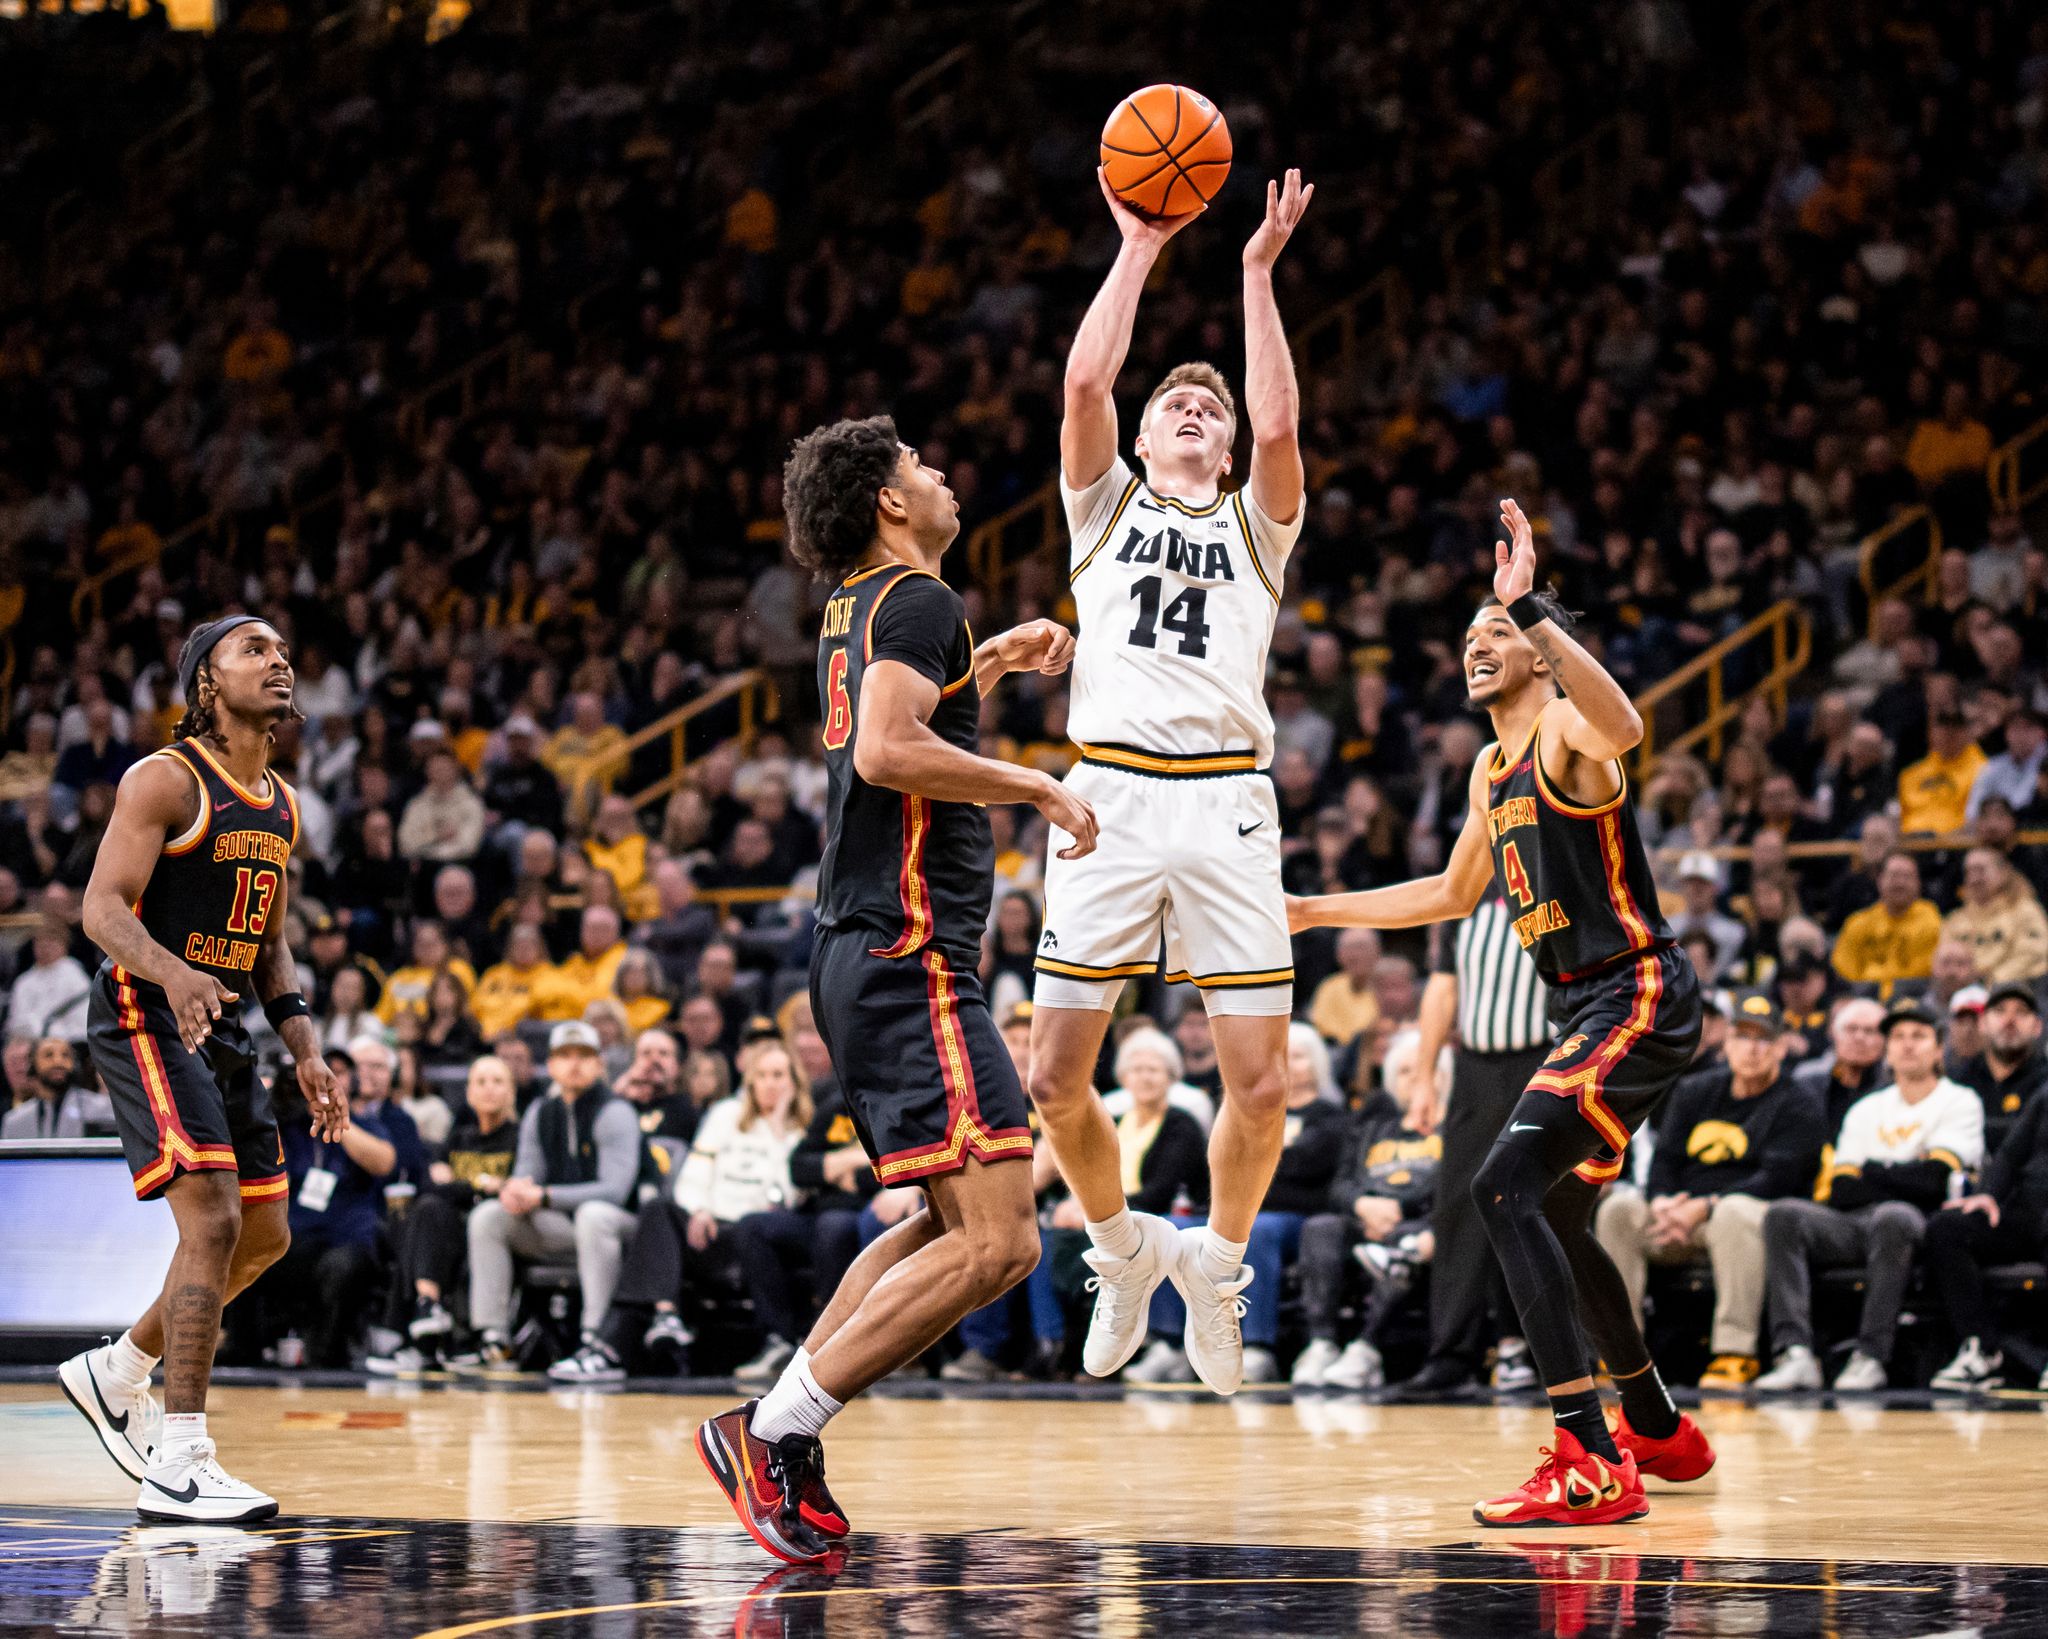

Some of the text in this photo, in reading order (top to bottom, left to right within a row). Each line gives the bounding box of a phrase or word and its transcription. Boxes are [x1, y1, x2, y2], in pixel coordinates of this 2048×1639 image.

[1115, 526, 1235, 582] IOWA
[824, 596, 857, 638] COFIE
[1128, 575, 1211, 660] 14
[822, 648, 853, 751] 6
[227, 867, 278, 935] 13
[1503, 840, 1534, 908] 4
